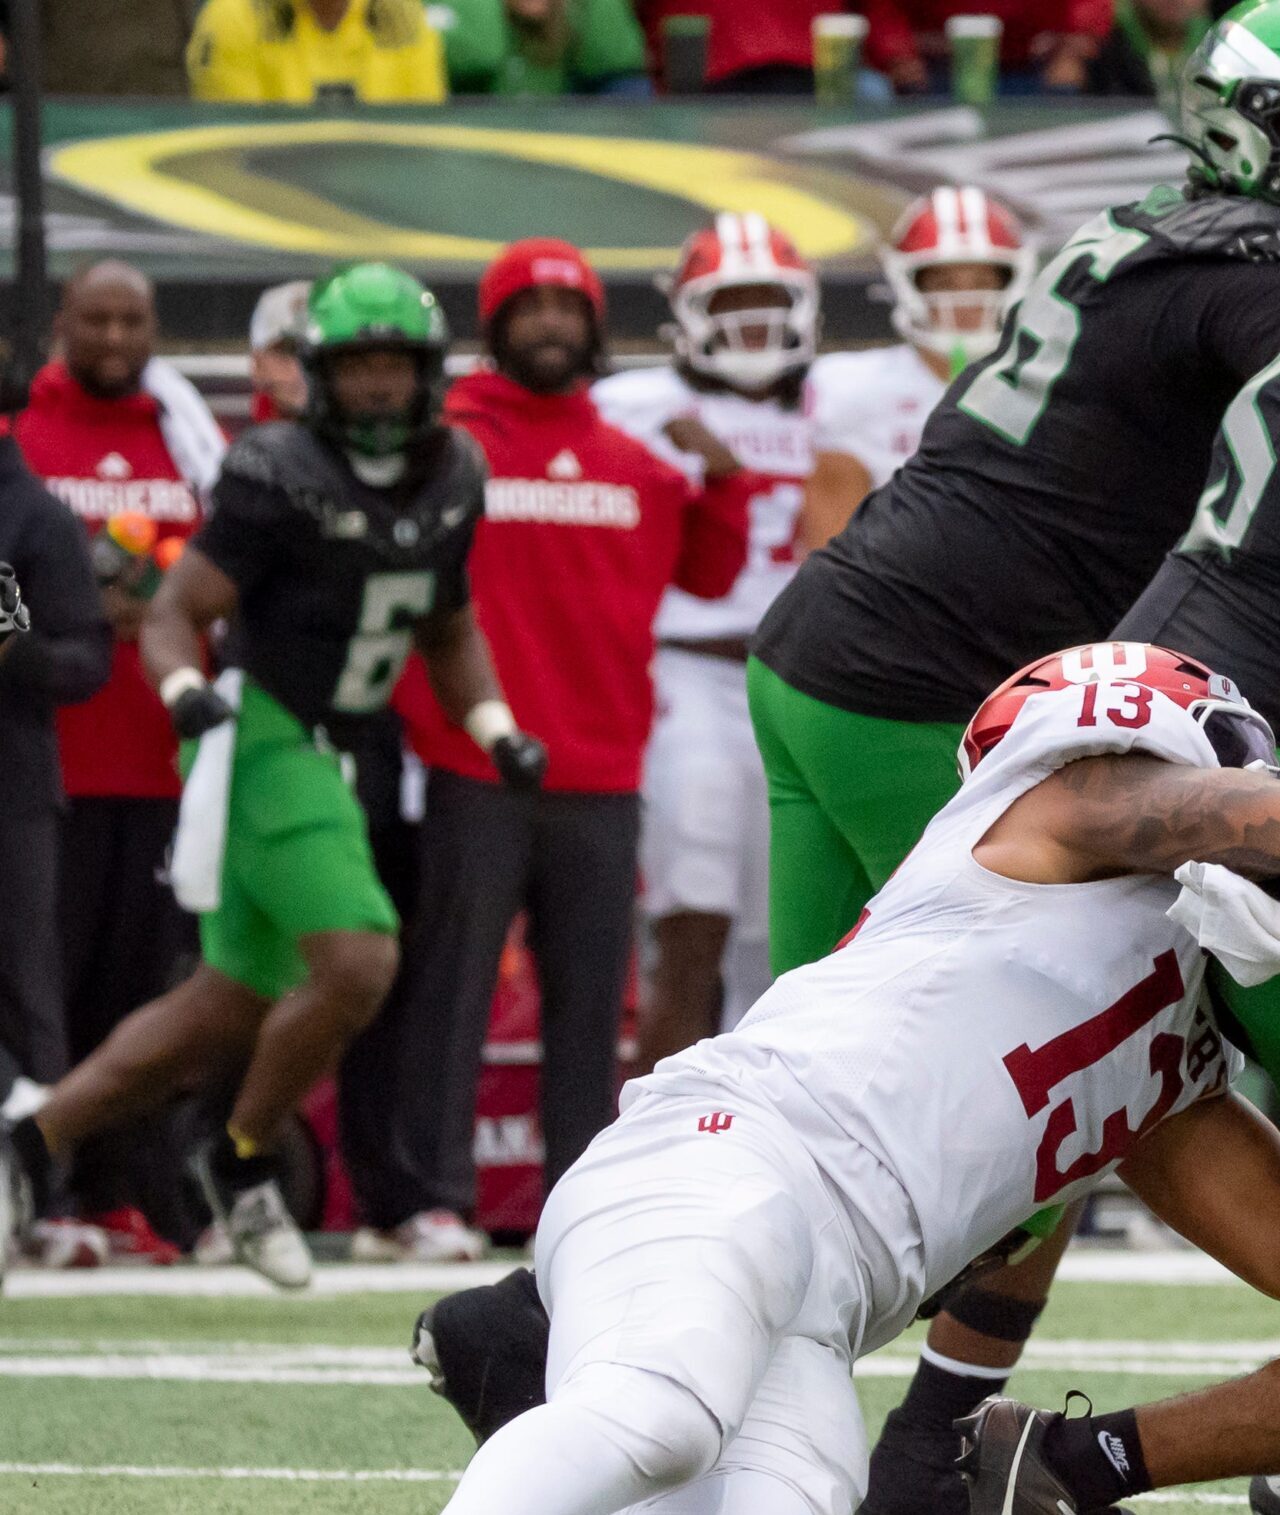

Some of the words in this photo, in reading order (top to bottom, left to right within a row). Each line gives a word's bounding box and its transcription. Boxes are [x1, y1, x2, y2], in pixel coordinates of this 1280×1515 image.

[331, 570, 437, 713] 6
[1077, 682, 1153, 729] 13
[1002, 947, 1185, 1204] 13
